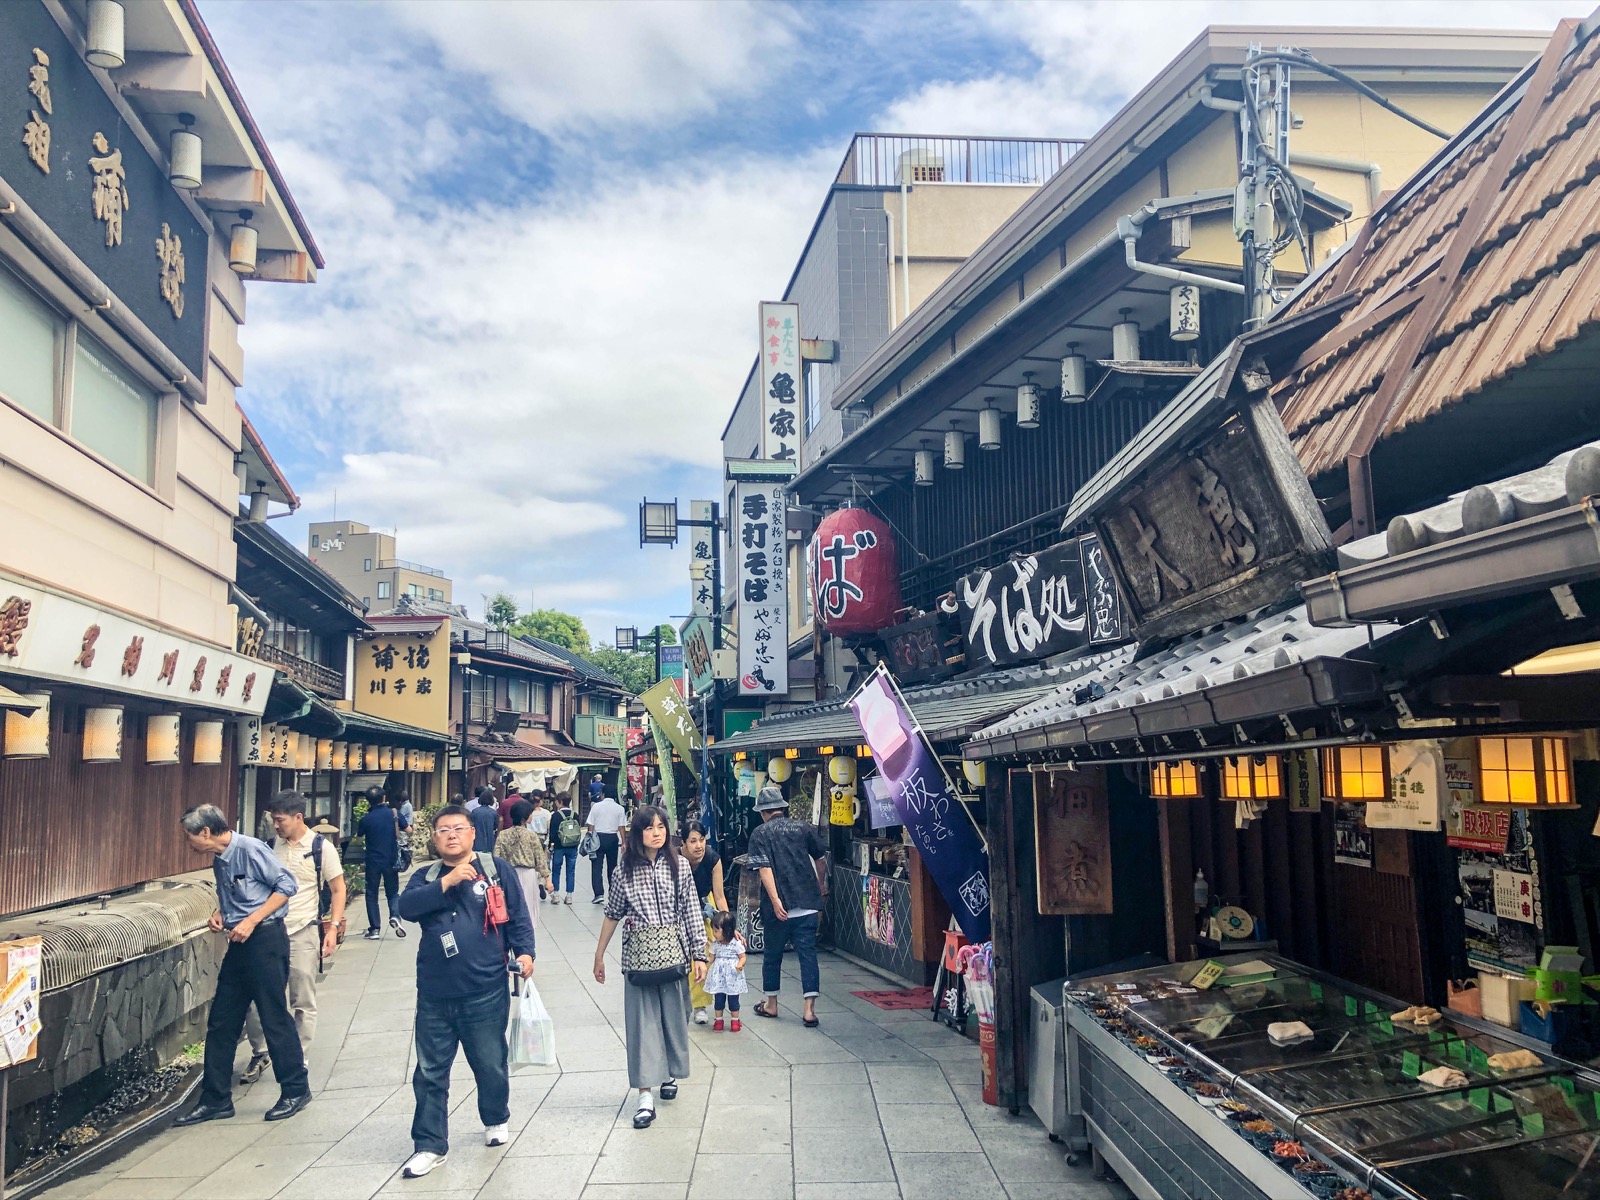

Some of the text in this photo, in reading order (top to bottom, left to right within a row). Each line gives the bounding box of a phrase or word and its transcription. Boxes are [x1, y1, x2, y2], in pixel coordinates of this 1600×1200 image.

[767, 316, 780, 366] 御食事
[320, 538, 345, 552] SMT
[742, 493, 769, 602] 手打そば
[963, 555, 1087, 664] そば処
[370, 677, 432, 695] 川千家
[248, 717, 260, 761] 川千家
[1463, 809, 1509, 838] 取扱店
[1520, 880, 1531, 918] 庚申
